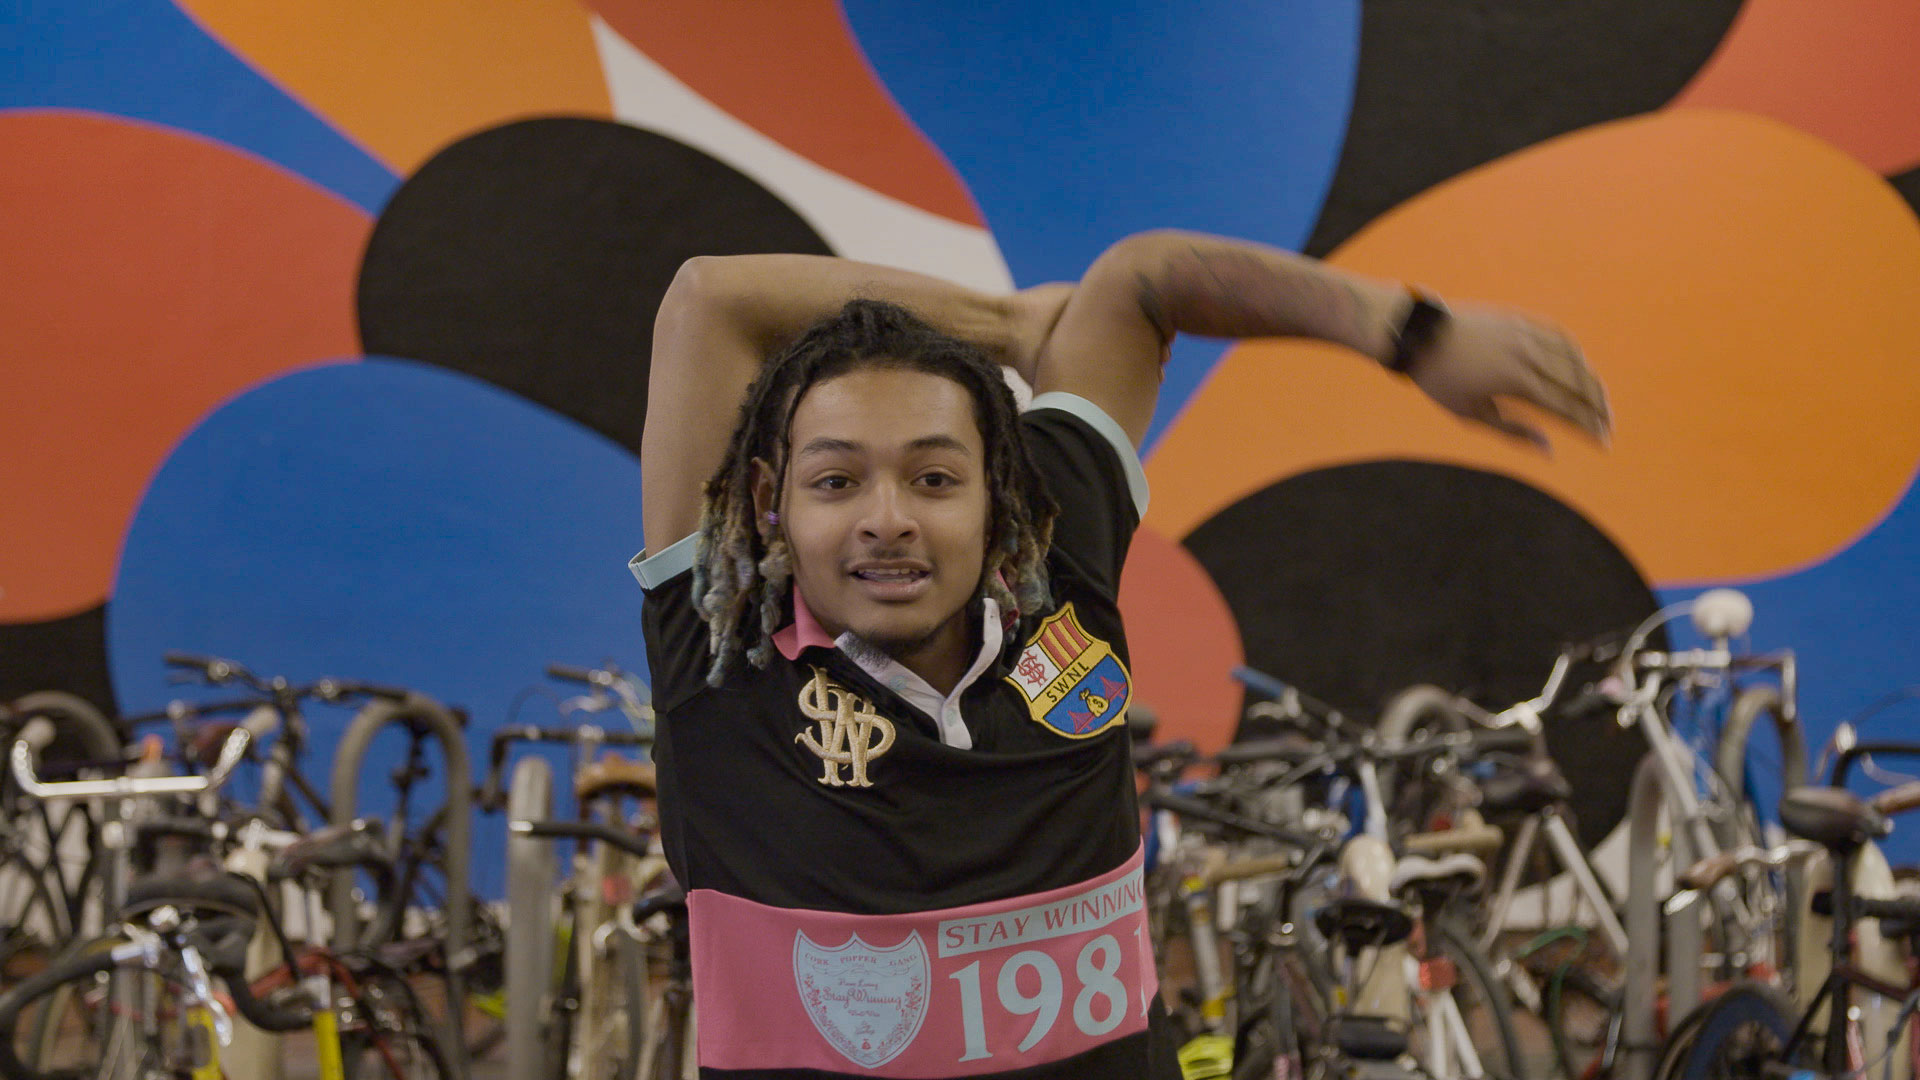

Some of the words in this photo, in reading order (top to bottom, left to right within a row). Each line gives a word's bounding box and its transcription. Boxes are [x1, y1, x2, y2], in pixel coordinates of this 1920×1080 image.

[1046, 661, 1090, 703] SWNL
[945, 915, 1030, 950] STAY
[804, 952, 830, 966] CORK
[840, 954, 877, 965] POPPER
[888, 953, 918, 967] GANG
[822, 986, 850, 1009] Stay
[848, 987, 903, 1012] Winning
